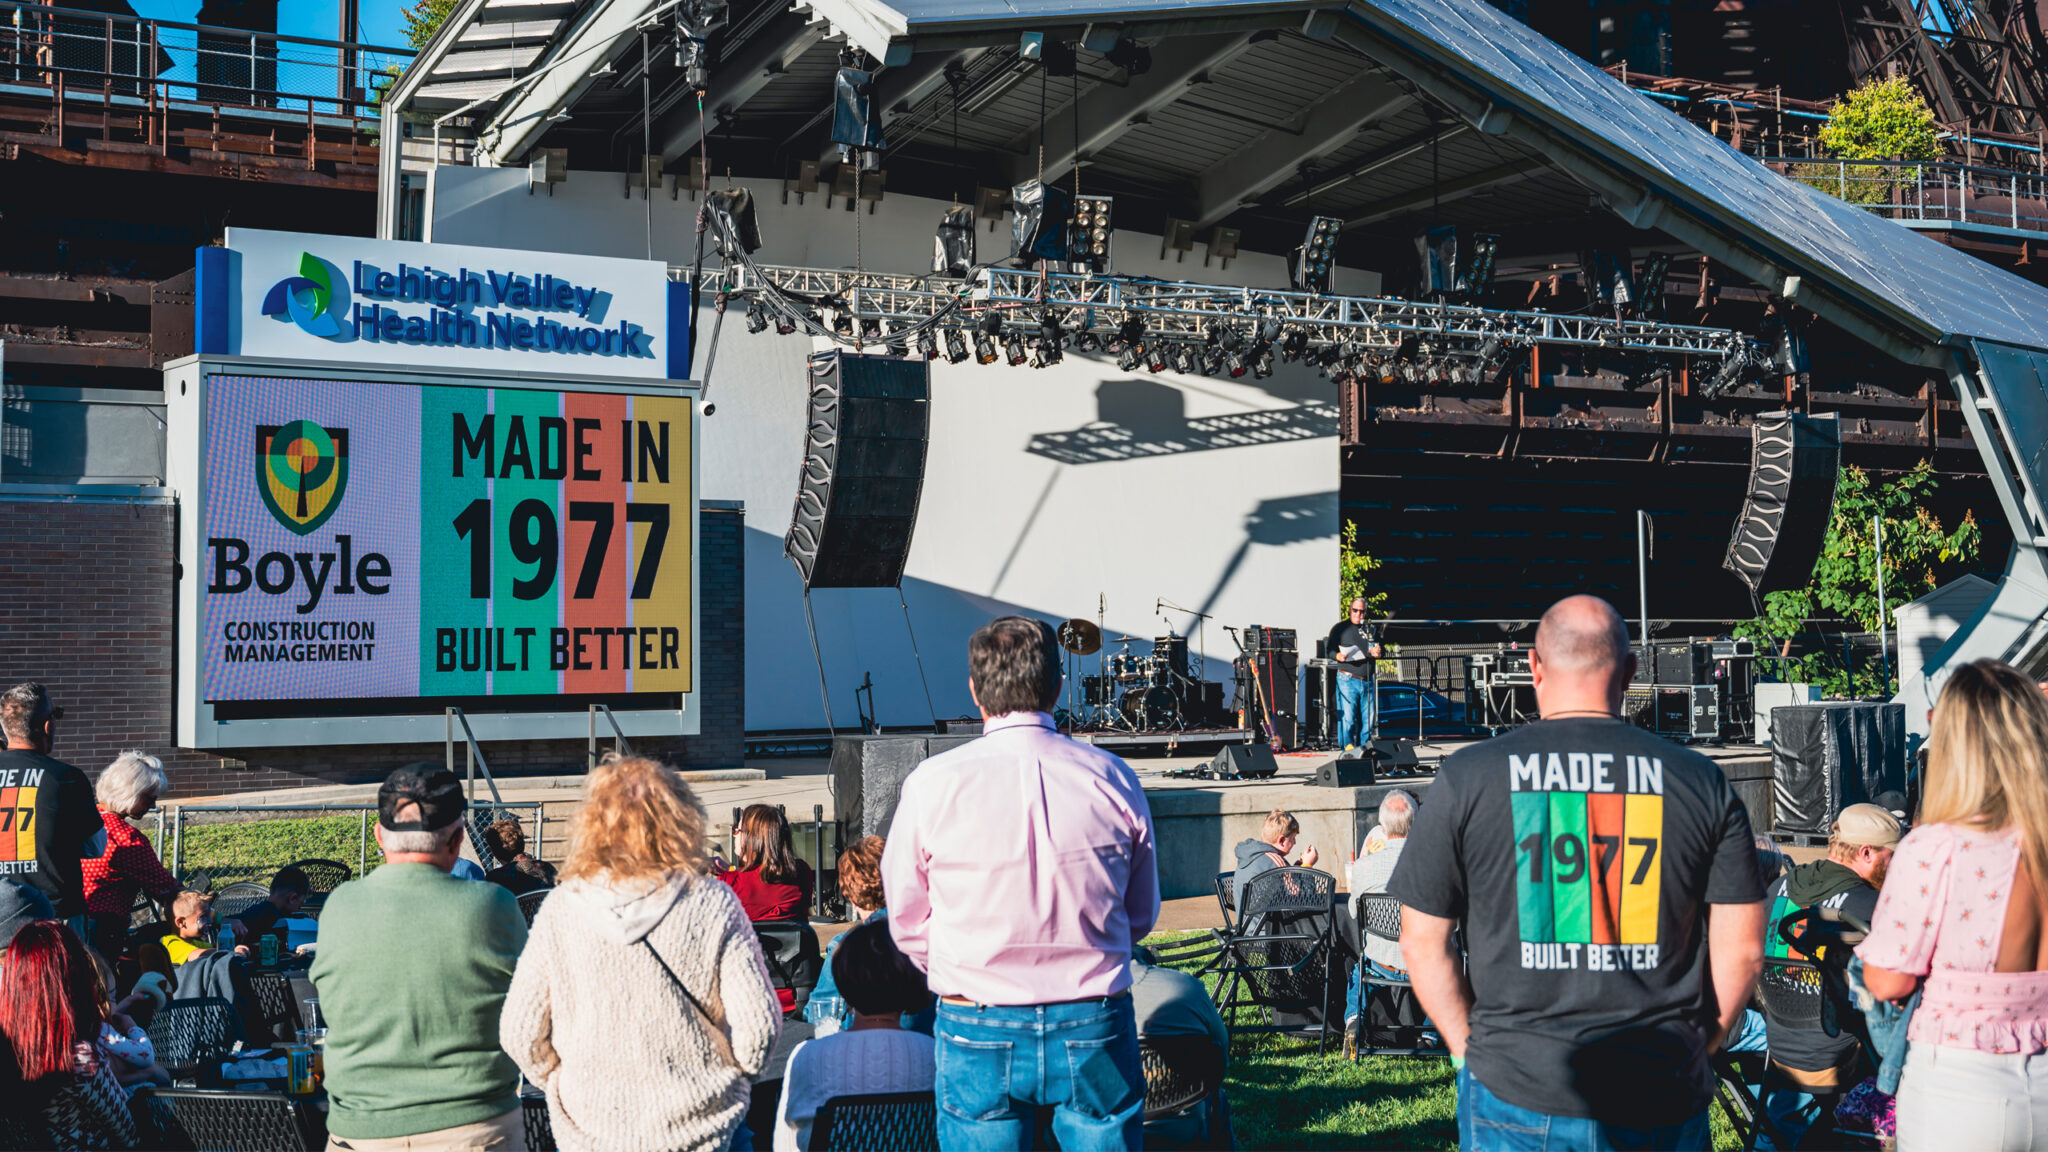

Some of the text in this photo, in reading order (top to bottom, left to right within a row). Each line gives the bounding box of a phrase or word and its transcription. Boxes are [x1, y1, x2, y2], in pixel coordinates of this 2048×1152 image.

[353, 259, 597, 318] Lehigh Valley
[352, 302, 641, 354] Health Network
[452, 412, 670, 484] MADE IN
[452, 498, 670, 601] 1977
[207, 534, 392, 615] Boyle
[224, 621, 375, 641] CONSTRUCTION
[224, 643, 375, 662] MANAGEMENT
[436, 626, 680, 672] BUILT BETTER
[21, 768, 46, 788] IN
[1508, 752, 1664, 795] MADE IN
[1518, 832, 1658, 886] 1977
[1520, 941, 1660, 972] BUILT BETTER
